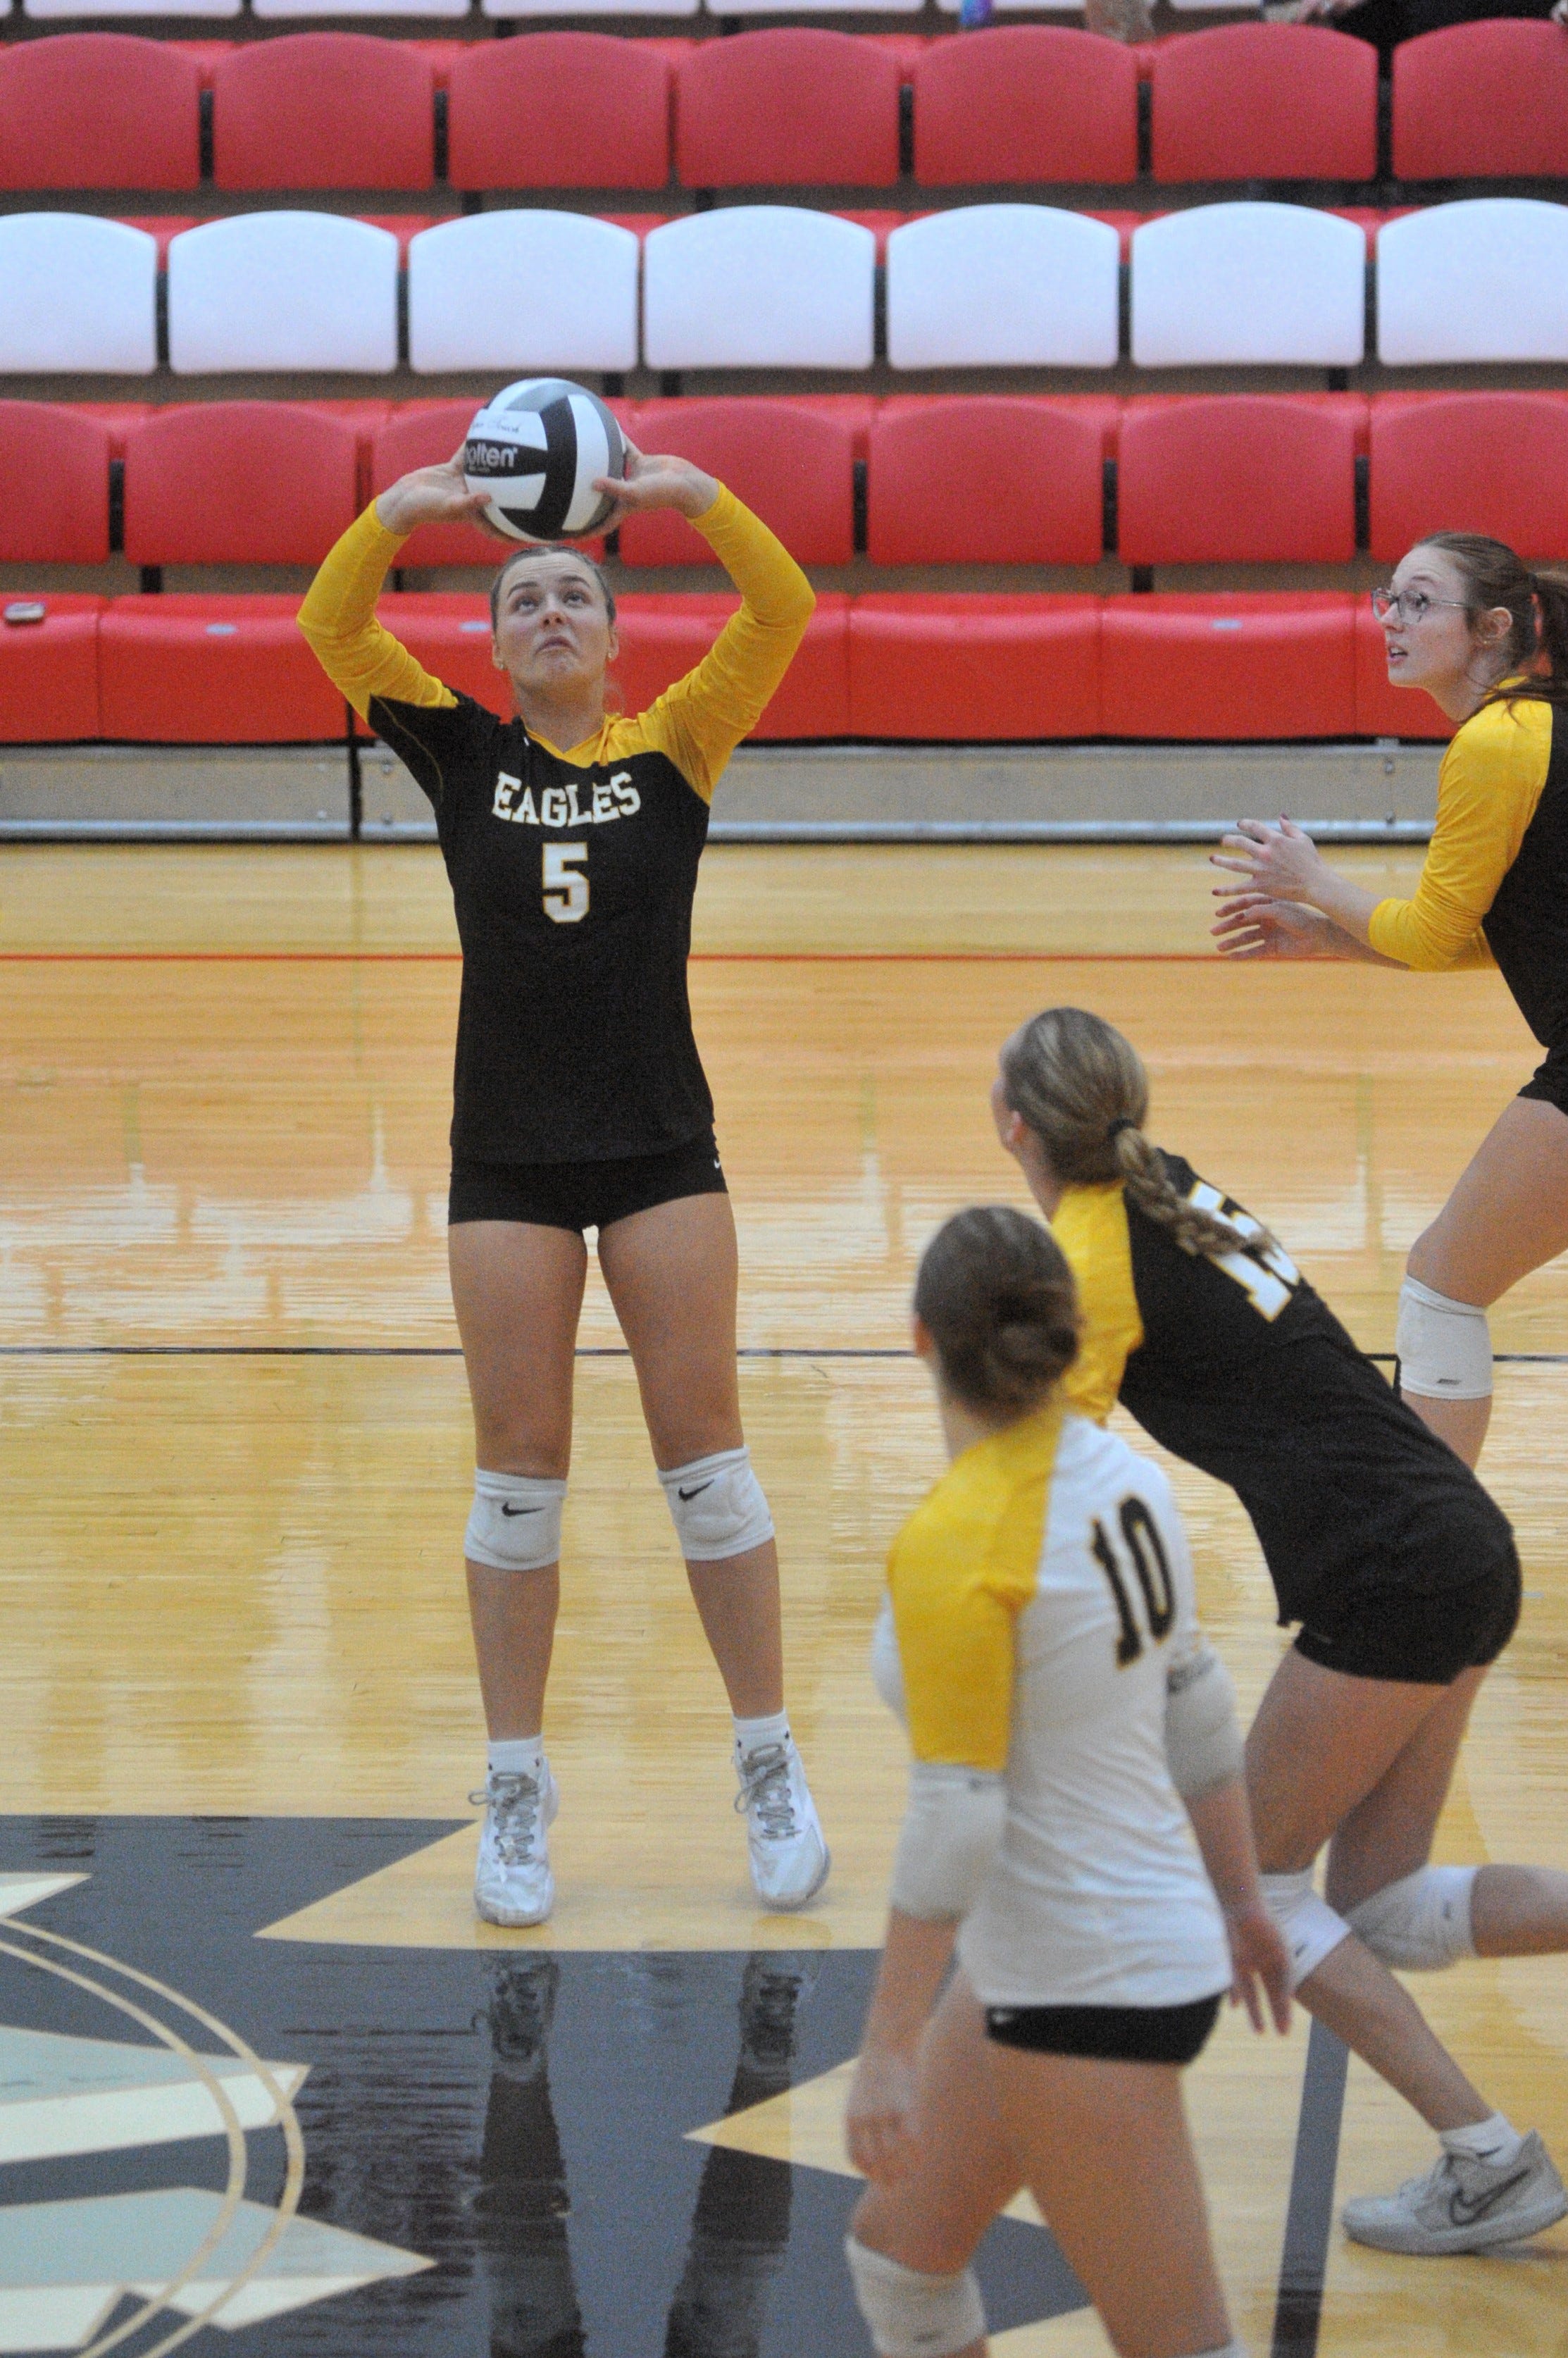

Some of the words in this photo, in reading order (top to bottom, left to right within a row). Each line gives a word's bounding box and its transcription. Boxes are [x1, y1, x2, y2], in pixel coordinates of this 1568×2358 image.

[492, 771, 641, 828] EAGLES
[542, 842, 590, 924] 5
[1090, 1493, 1176, 1670] 10
